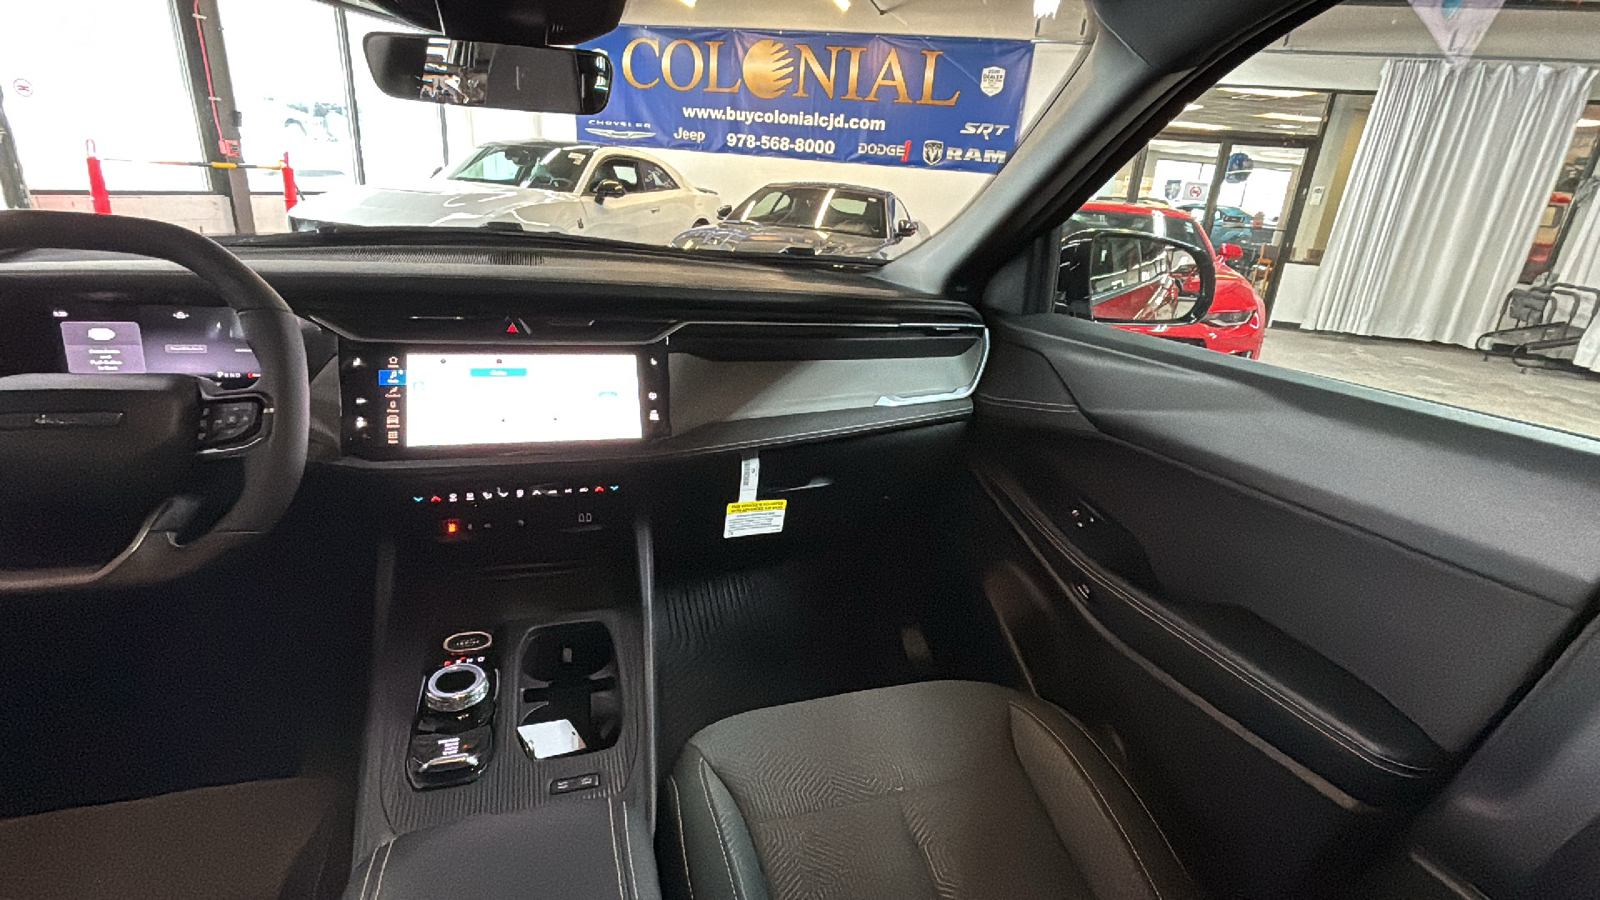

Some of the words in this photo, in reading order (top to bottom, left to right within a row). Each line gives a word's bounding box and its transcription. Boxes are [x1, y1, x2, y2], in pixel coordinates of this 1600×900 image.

[621, 37, 961, 106] COLONIAL
[682, 106, 886, 131] www.buycolonialcjd.com
[673, 127, 706, 144] Jeep
[959, 122, 1010, 141] SRT
[726, 133, 836, 155] 978-568-8000
[857, 142, 906, 157] DODGE
[945, 147, 1007, 164] RAM
